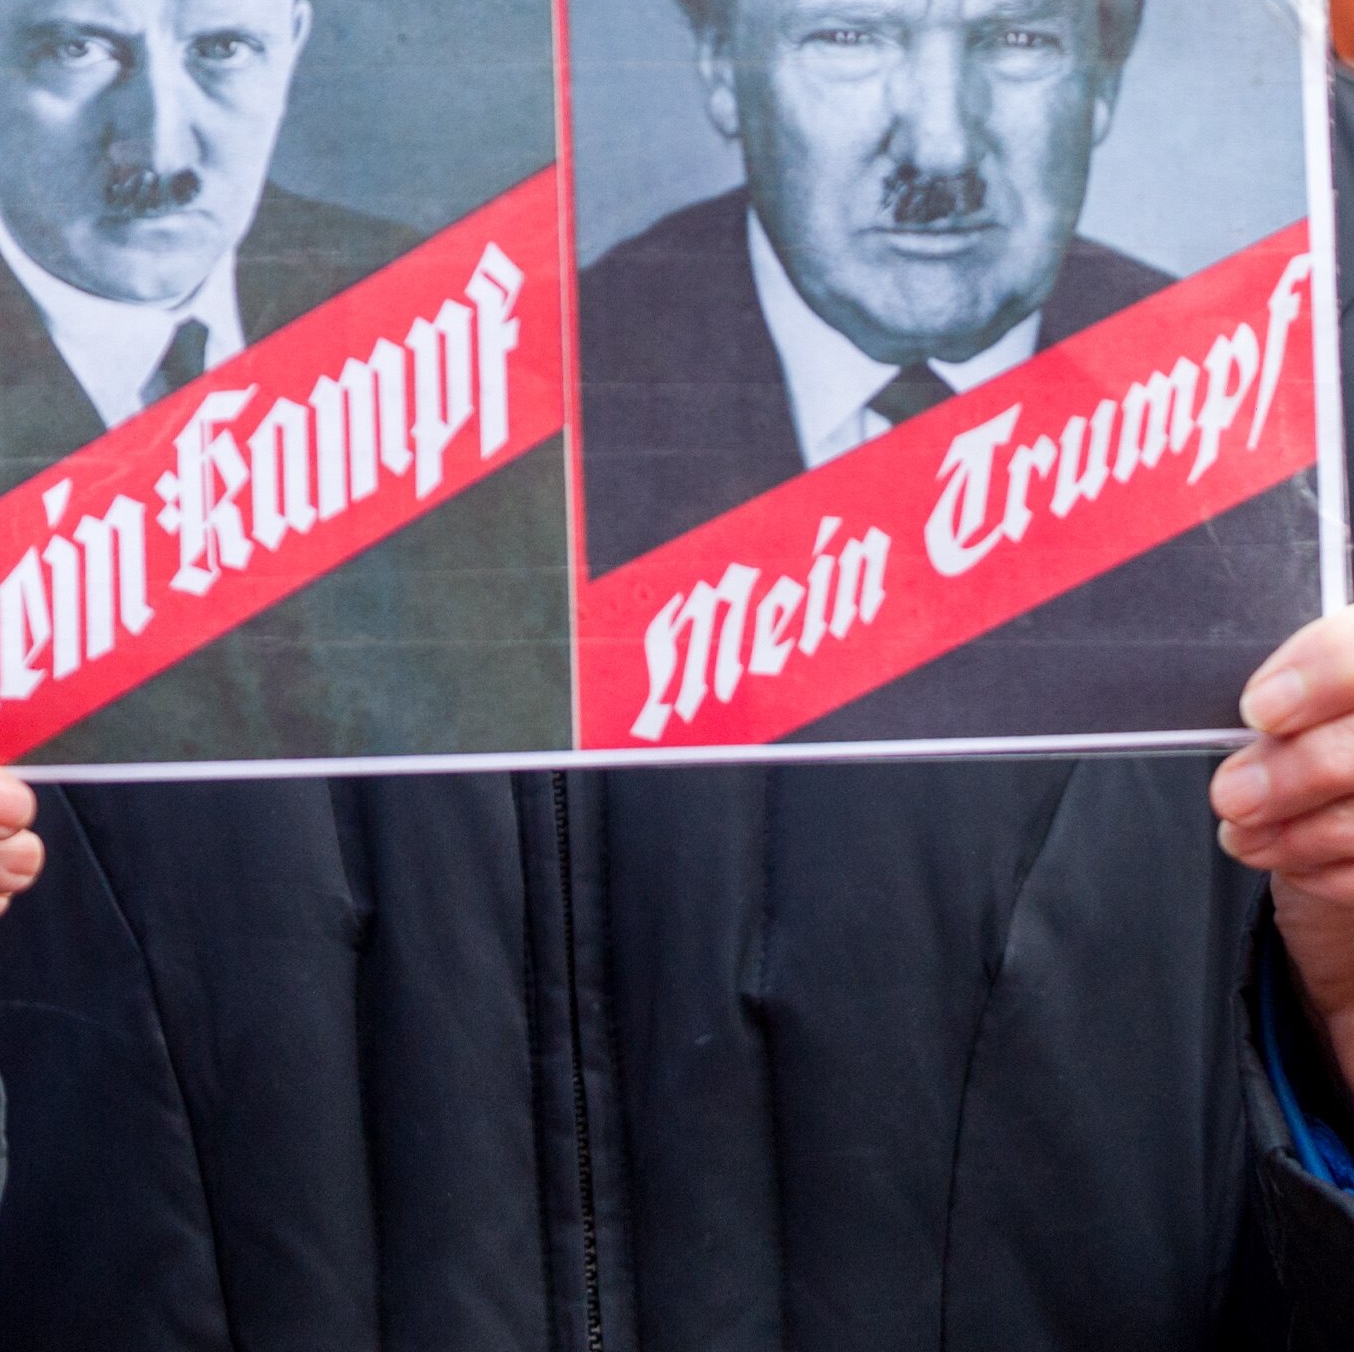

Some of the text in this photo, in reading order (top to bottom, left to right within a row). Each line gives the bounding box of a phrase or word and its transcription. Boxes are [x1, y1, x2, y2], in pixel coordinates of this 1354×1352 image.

[153, 240, 525, 597] Kampf
[629, 251, 1314, 743] Mein Trumpf
